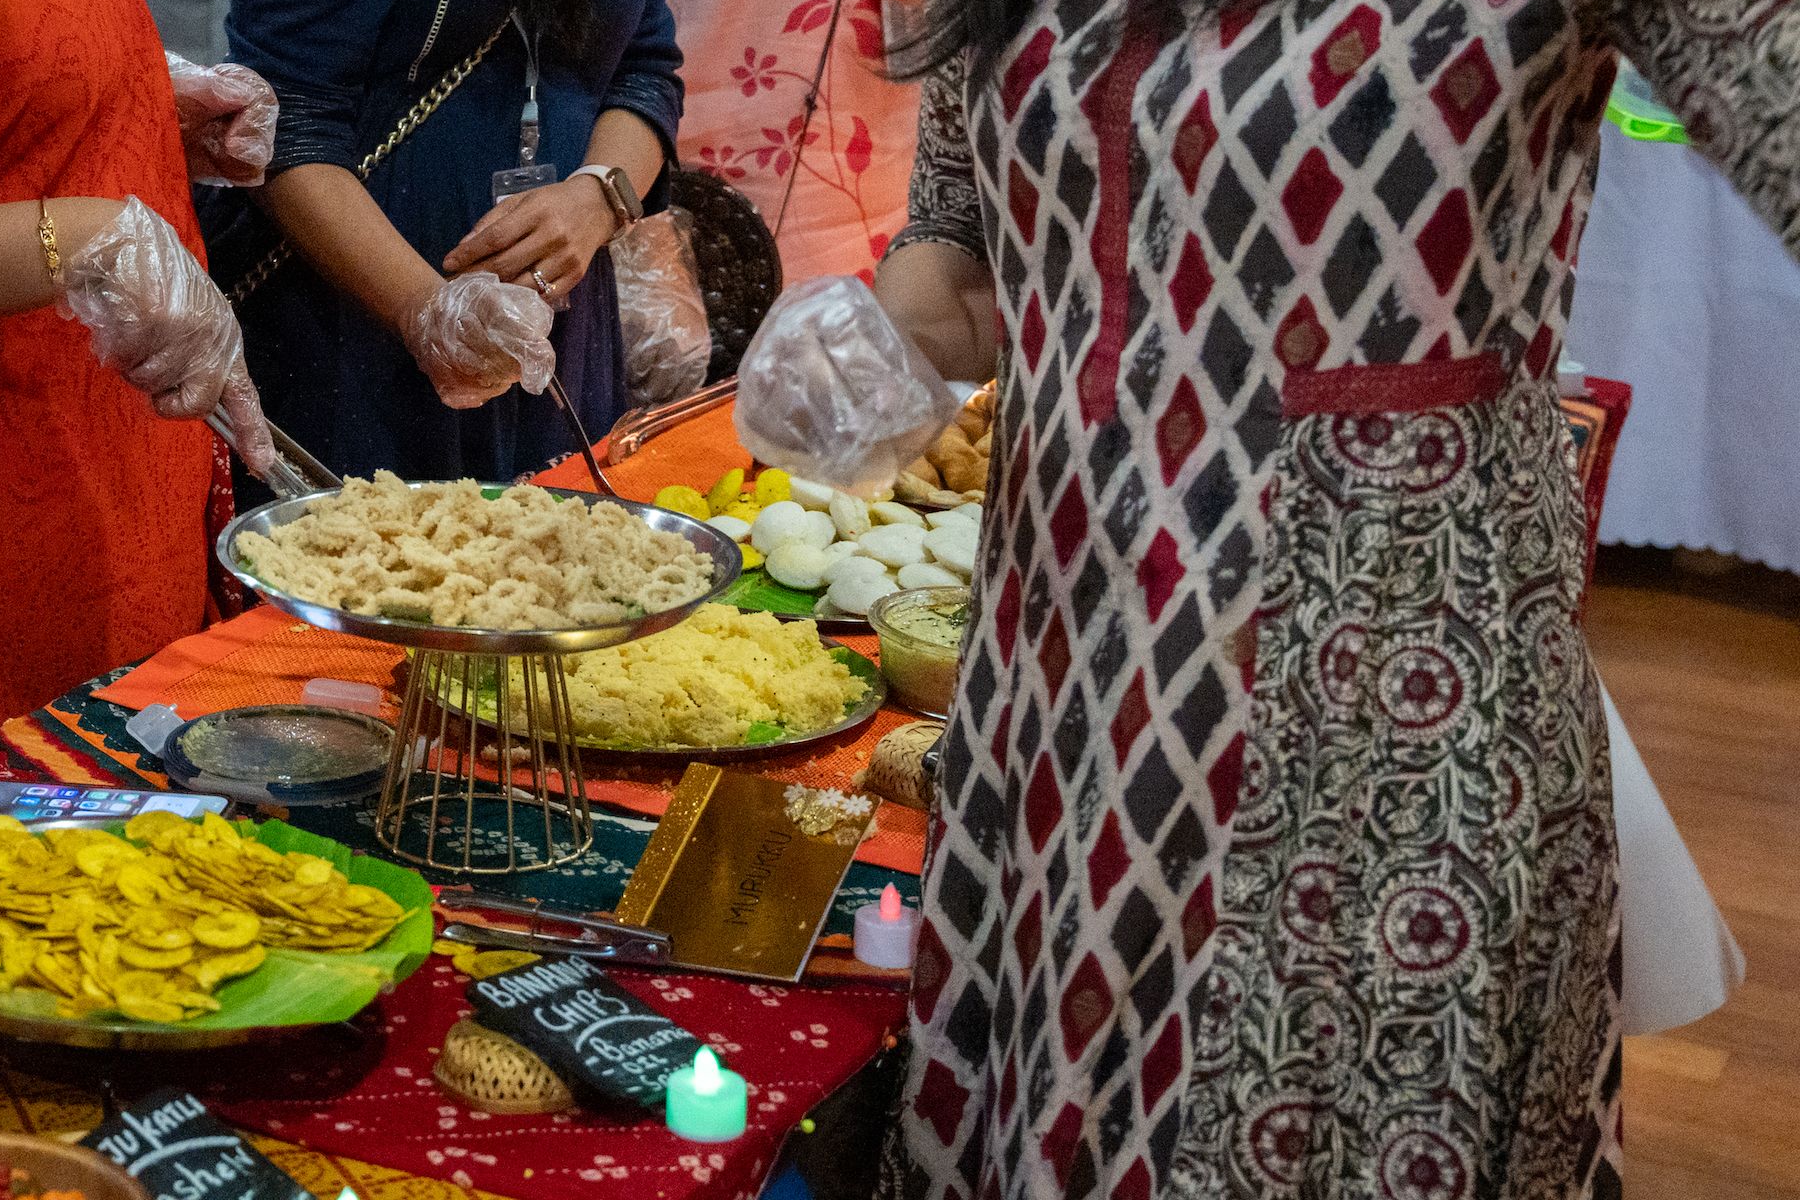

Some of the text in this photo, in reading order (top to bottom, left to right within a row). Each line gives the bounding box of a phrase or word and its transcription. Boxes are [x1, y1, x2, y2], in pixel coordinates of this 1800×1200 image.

[723, 830, 792, 925] MURUKKU
[477, 954, 605, 1008] BANANA
[534, 988, 630, 1031] CHIPS
[589, 1028, 696, 1061] Banana
[621, 1054, 668, 1074] OIL
[98, 1093, 206, 1165] JU KATLI
[157, 1146, 254, 1200] shew
